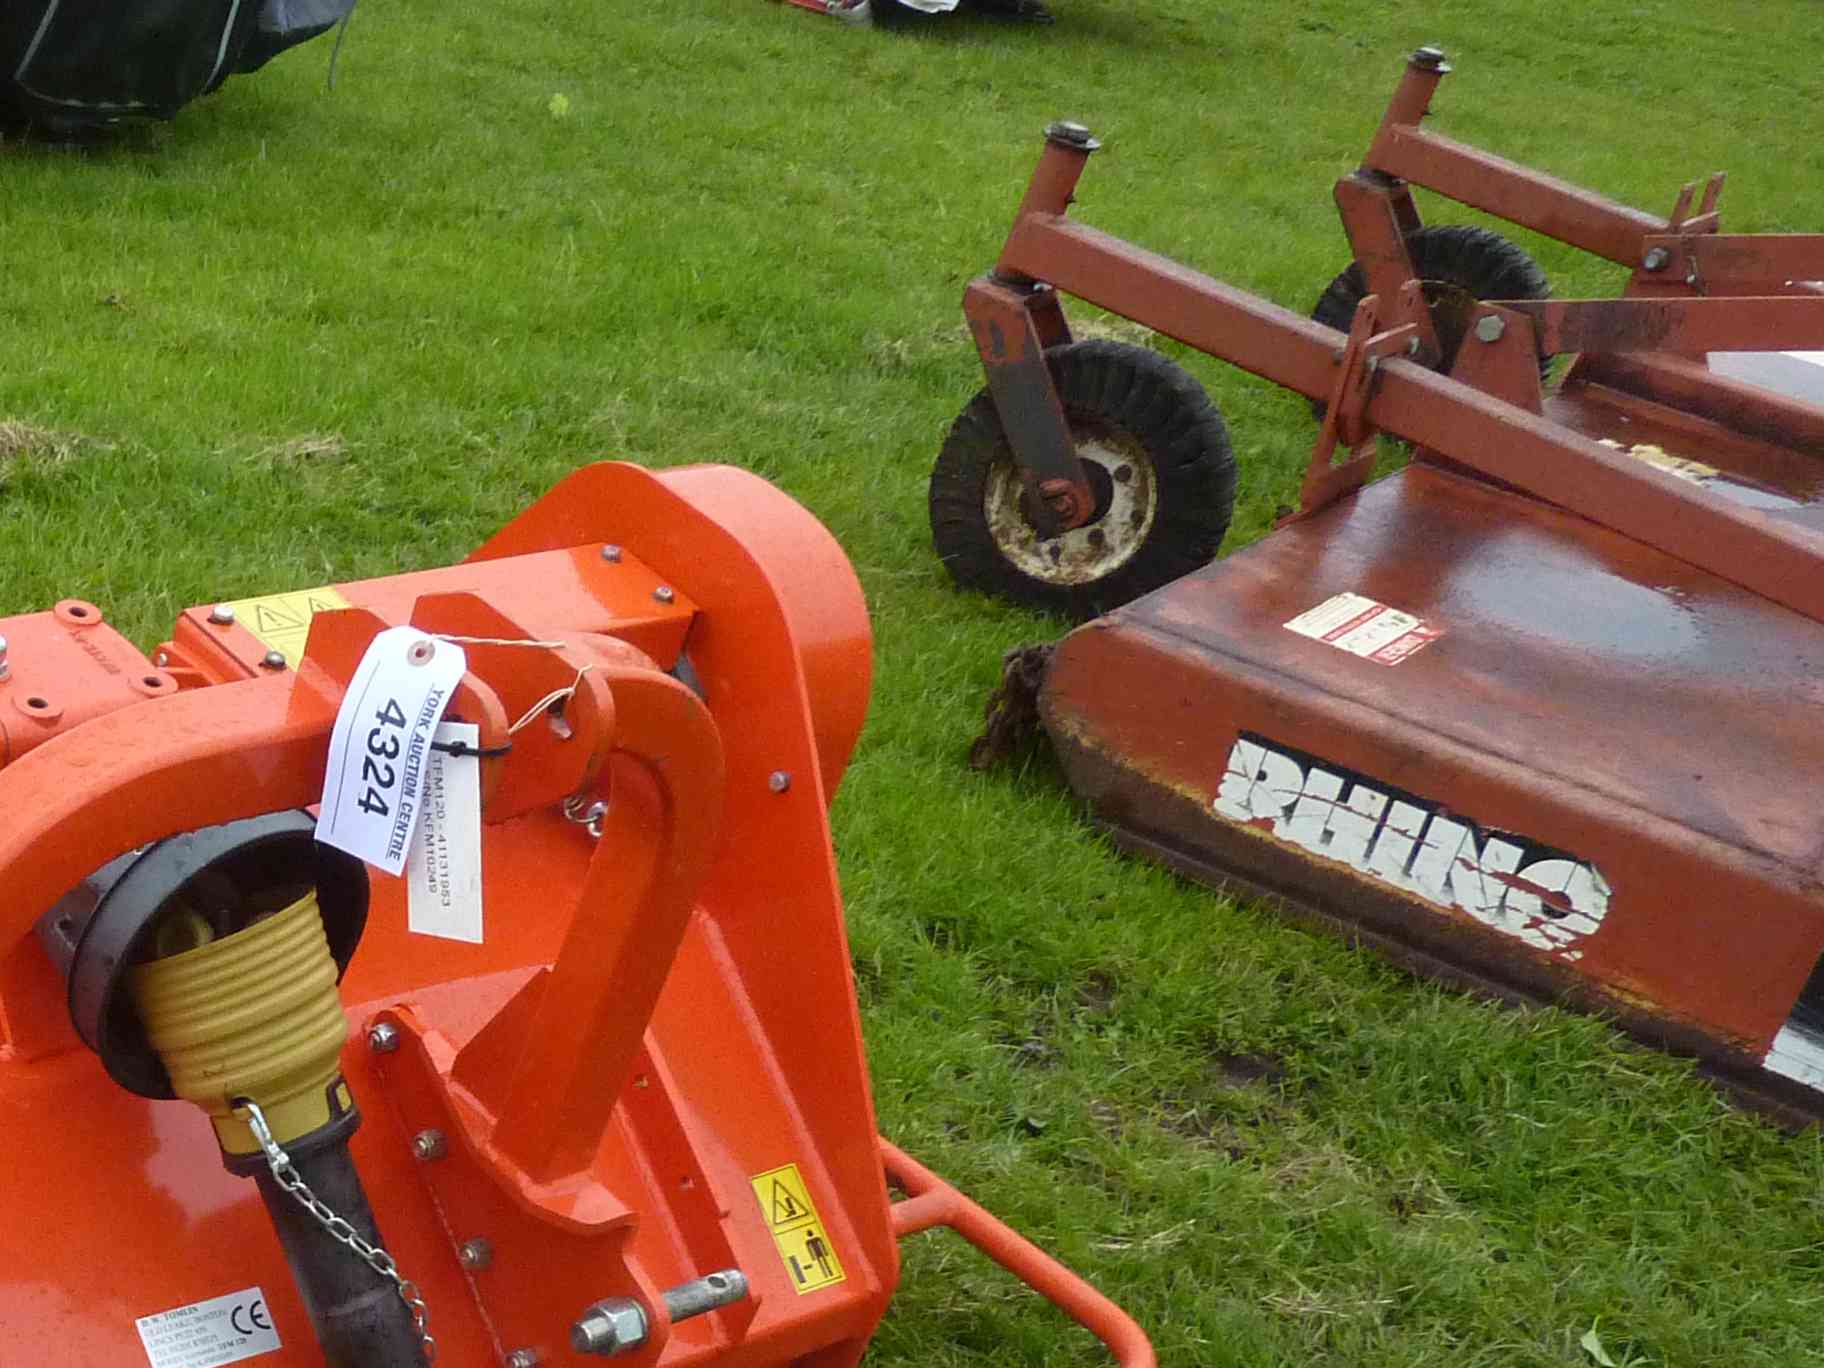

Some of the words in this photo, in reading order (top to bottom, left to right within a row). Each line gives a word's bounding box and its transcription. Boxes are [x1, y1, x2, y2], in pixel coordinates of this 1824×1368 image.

[419, 688, 445, 730] YORK
[358, 698, 407, 817] 4324
[404, 735, 426, 799] AUCTION
[389, 802, 414, 861] CENTRE
[1212, 733, 1614, 961] RHINO
[230, 1299, 272, 1335] CE
